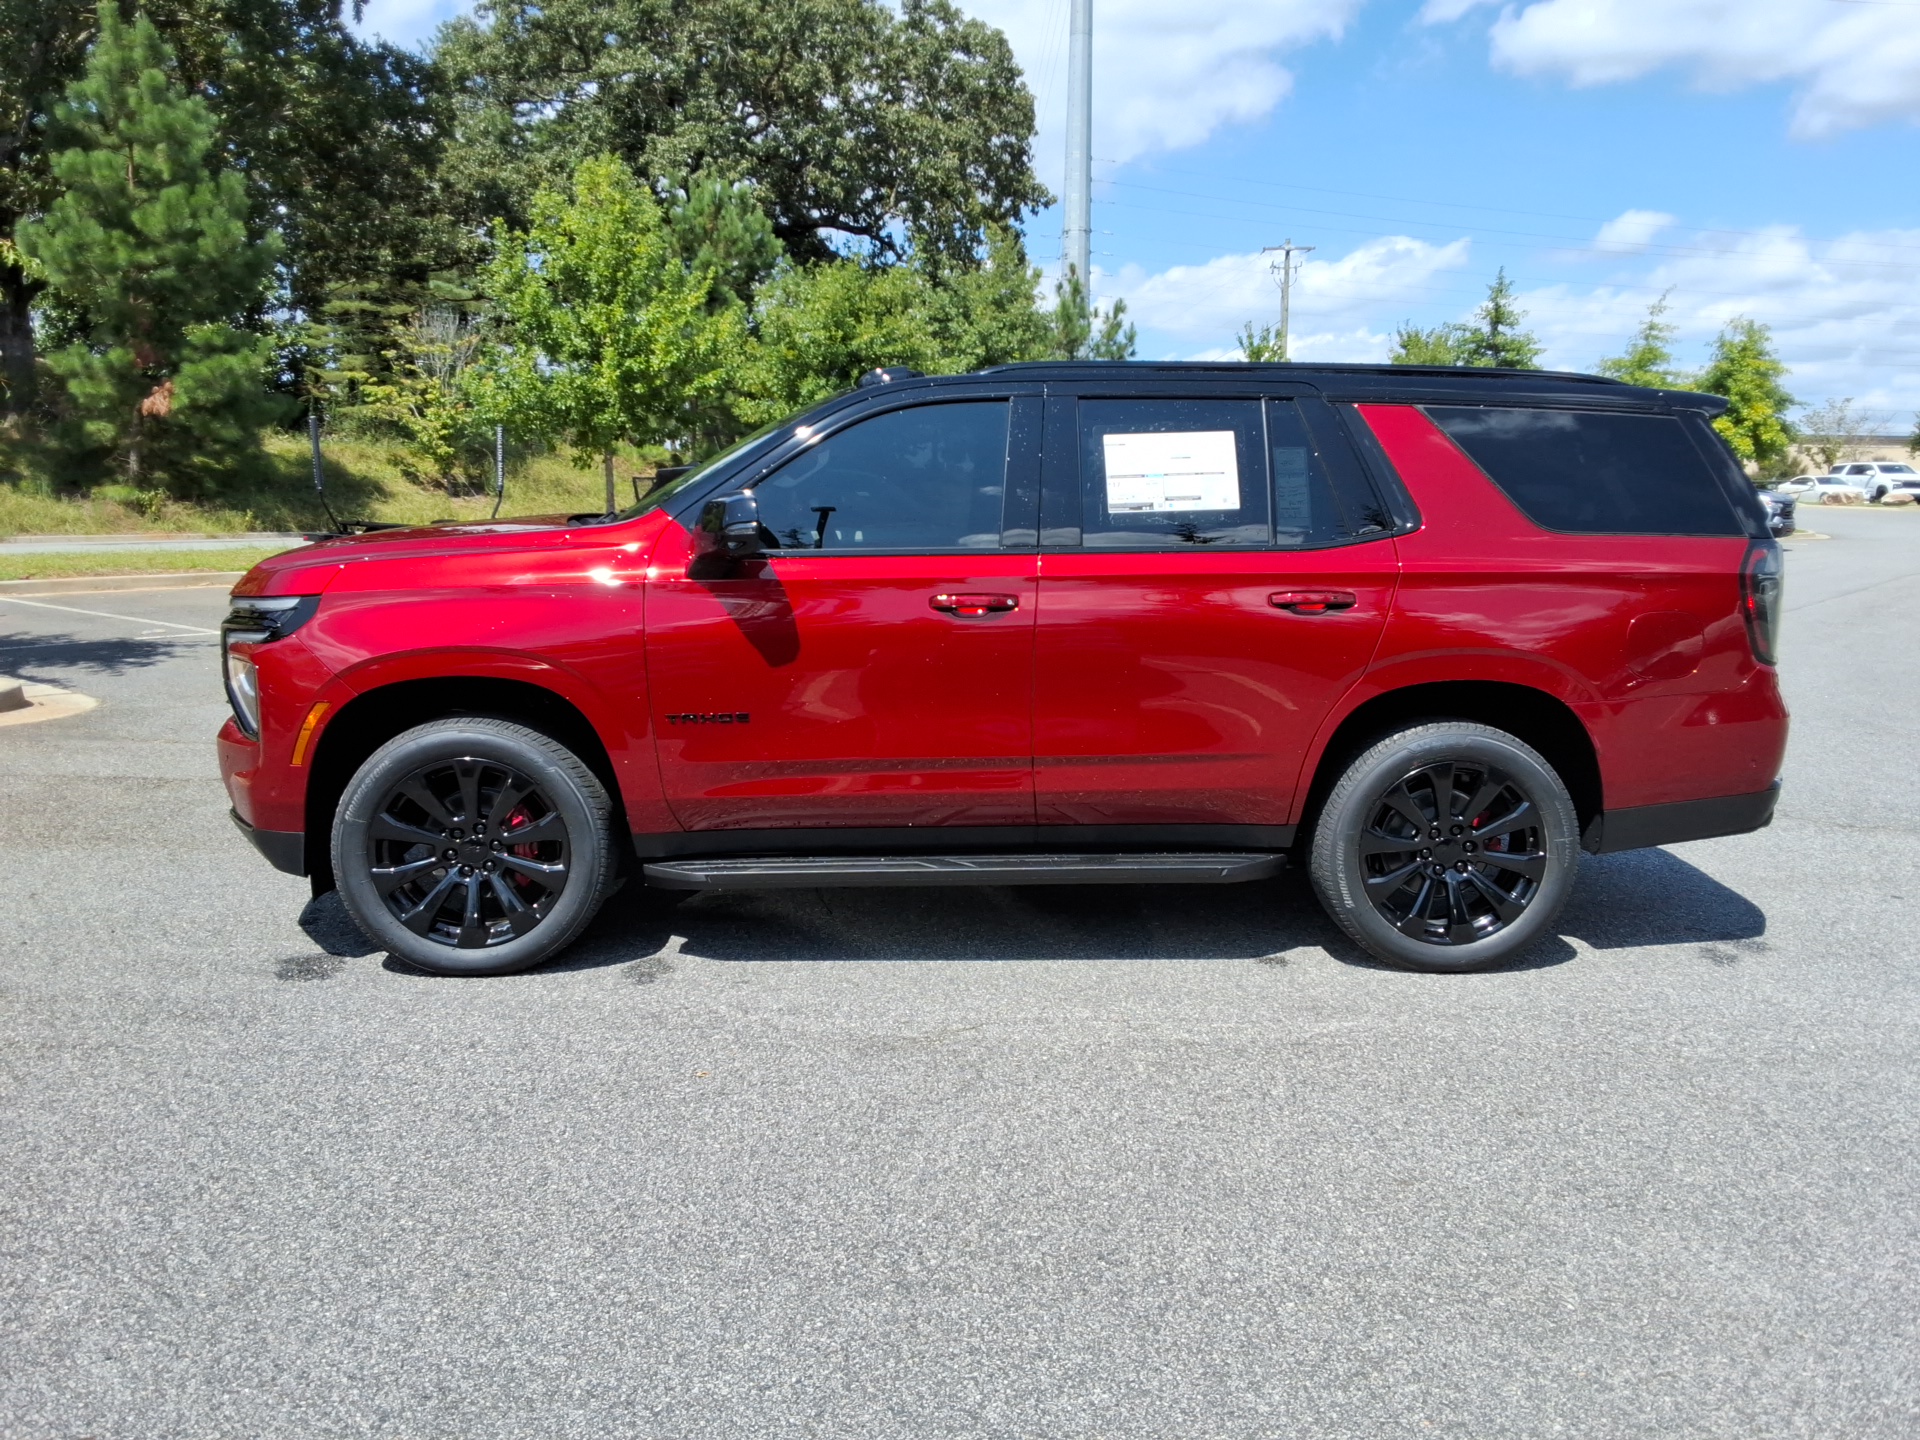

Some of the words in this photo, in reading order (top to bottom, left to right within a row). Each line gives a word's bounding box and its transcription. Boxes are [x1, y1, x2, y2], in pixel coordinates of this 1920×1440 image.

[665, 712, 750, 725] TAHOE
[344, 757, 393, 821] BRIDGESTONE
[1336, 841, 1356, 908] BRIDGESTONE
